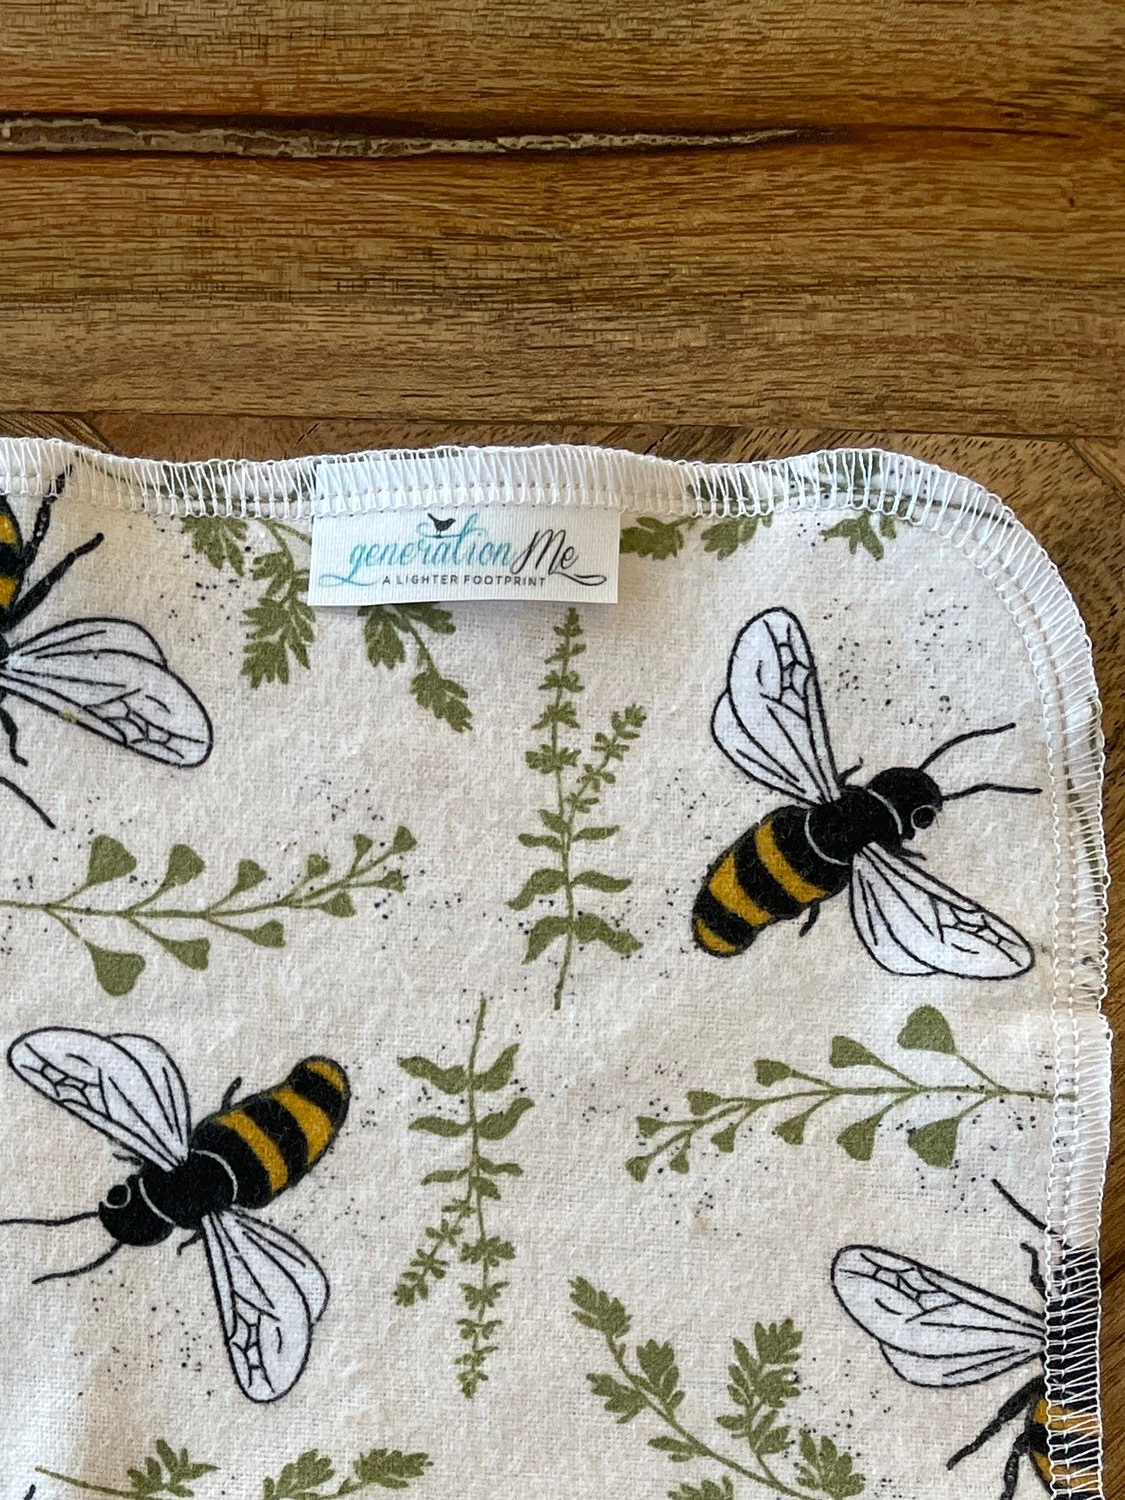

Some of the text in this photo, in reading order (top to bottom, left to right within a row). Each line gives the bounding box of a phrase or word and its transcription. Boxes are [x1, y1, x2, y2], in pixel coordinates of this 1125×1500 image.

[382, 574, 546, 587] A LIGHTER FOOTPRINT
